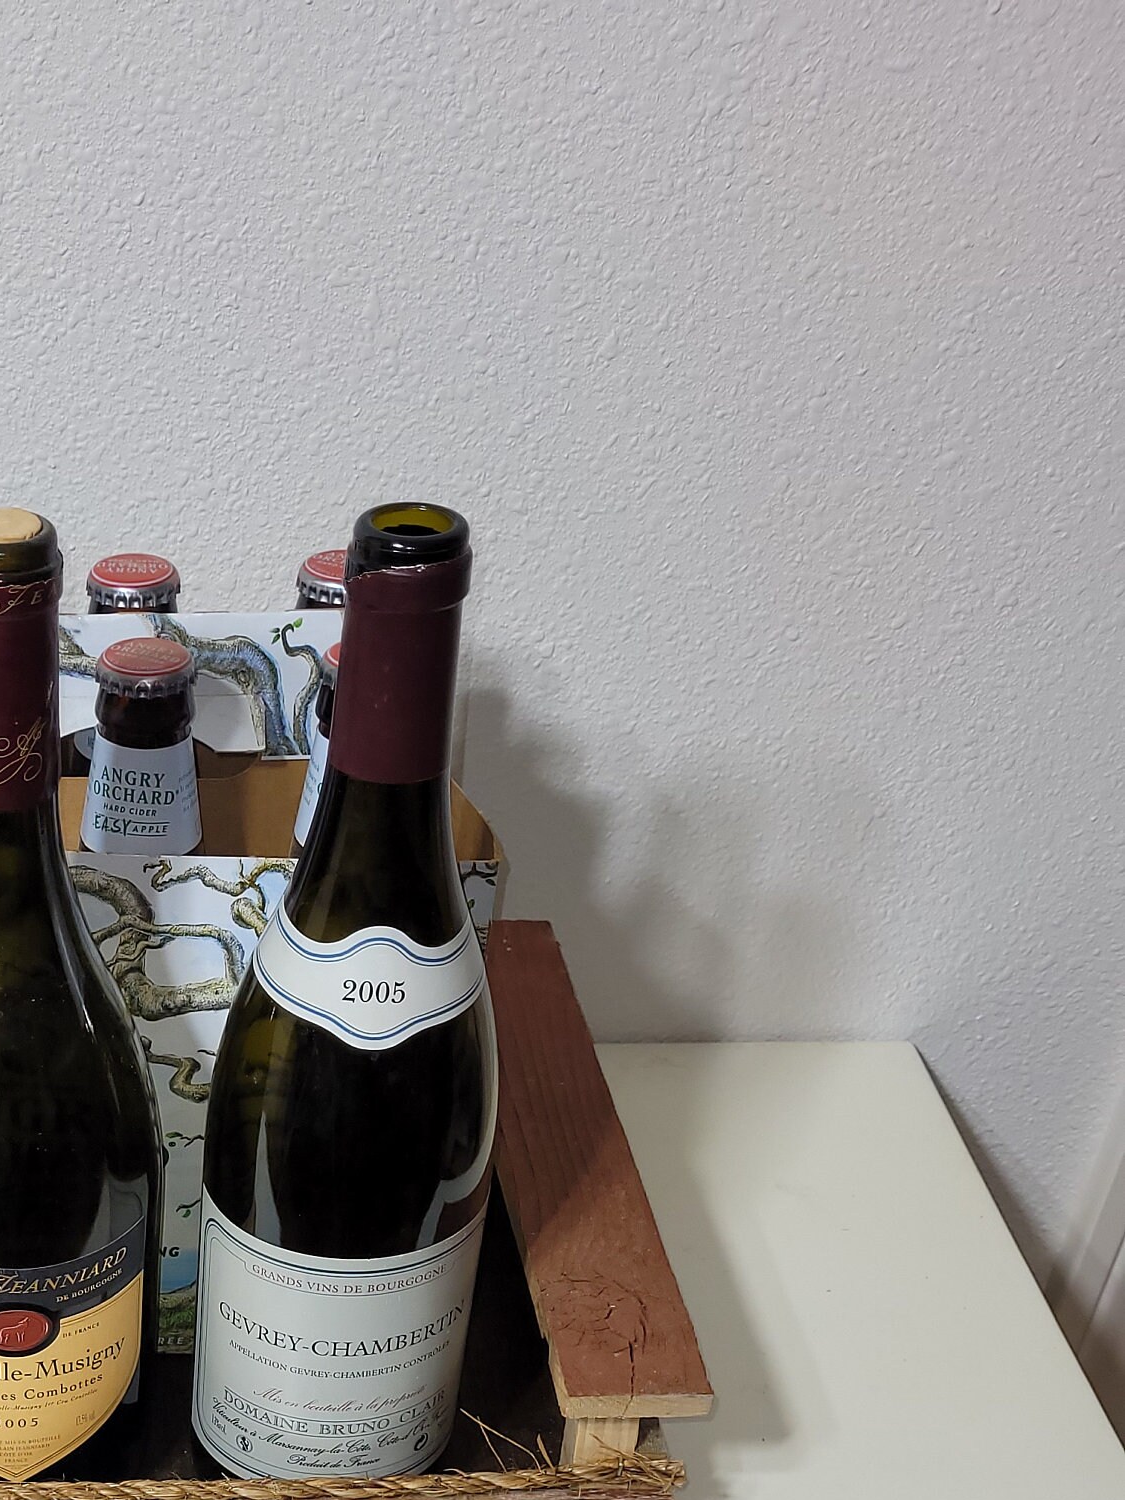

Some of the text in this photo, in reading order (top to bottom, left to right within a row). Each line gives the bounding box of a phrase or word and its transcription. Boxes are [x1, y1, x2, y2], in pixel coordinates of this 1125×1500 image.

[101, 765, 165, 788] ANGRY
[94, 780, 175, 805] ORCHARD
[104, 803, 157, 816] HARD CIDER
[94, 815, 169, 836] EASY APPLE
[342, 980, 405, 1003] 2005
[56, 1267, 124, 1303] DE BOURGOGNE
[252, 1263, 447, 1294] GRANDS VINS DE BOURGOGNE
[75, 1321, 100, 1335] FRANCE
[158, 1336, 184, 1345] REE
[219, 1299, 465, 1357] GEVREY-CHAMBERTIN
[230, 1339, 288, 1371] APPELLATION
[290, 1363, 402, 1379] GEVREY-CHAMBERTIN
[24, 1373, 103, 1400] Combottes
[224, 1389, 309, 1433] DOMAINE
[319, 1418, 390, 1435] BRUNO
[400, 1389, 445, 1423] CLAIR
[253, 1387, 283, 1404] Mis
[285, 1400, 298, 1408] en
[303, 1399, 353, 1412] bouteille
[330, 1459, 342, 1468] de
[343, 1454, 381, 1468] France
